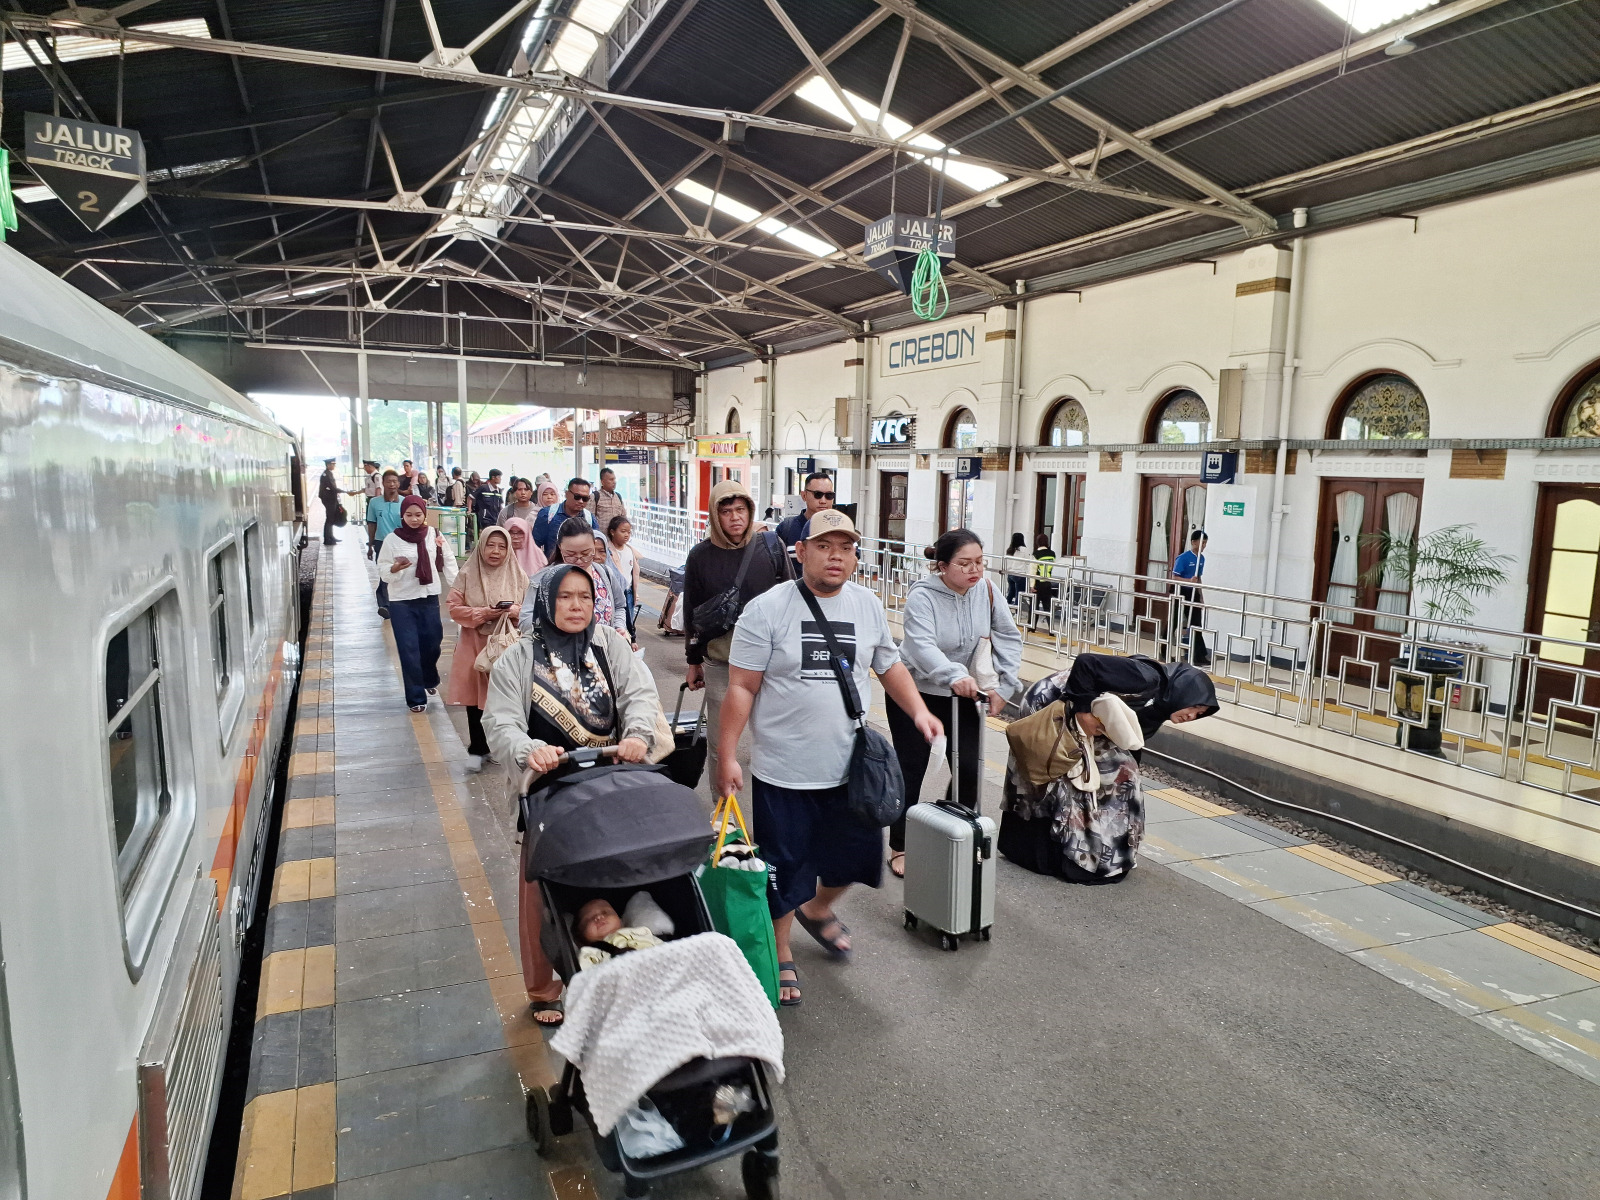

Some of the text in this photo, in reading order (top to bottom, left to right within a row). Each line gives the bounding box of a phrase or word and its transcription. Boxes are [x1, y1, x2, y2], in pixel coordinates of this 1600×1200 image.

[36, 121, 132, 157] JALUR
[54, 149, 114, 171] TRACK
[77, 190, 100, 213] 2
[867, 219, 894, 245] JALUR
[870, 239, 888, 255] TRACK
[889, 325, 975, 369] CIREBON
[870, 417, 908, 443] KFC
